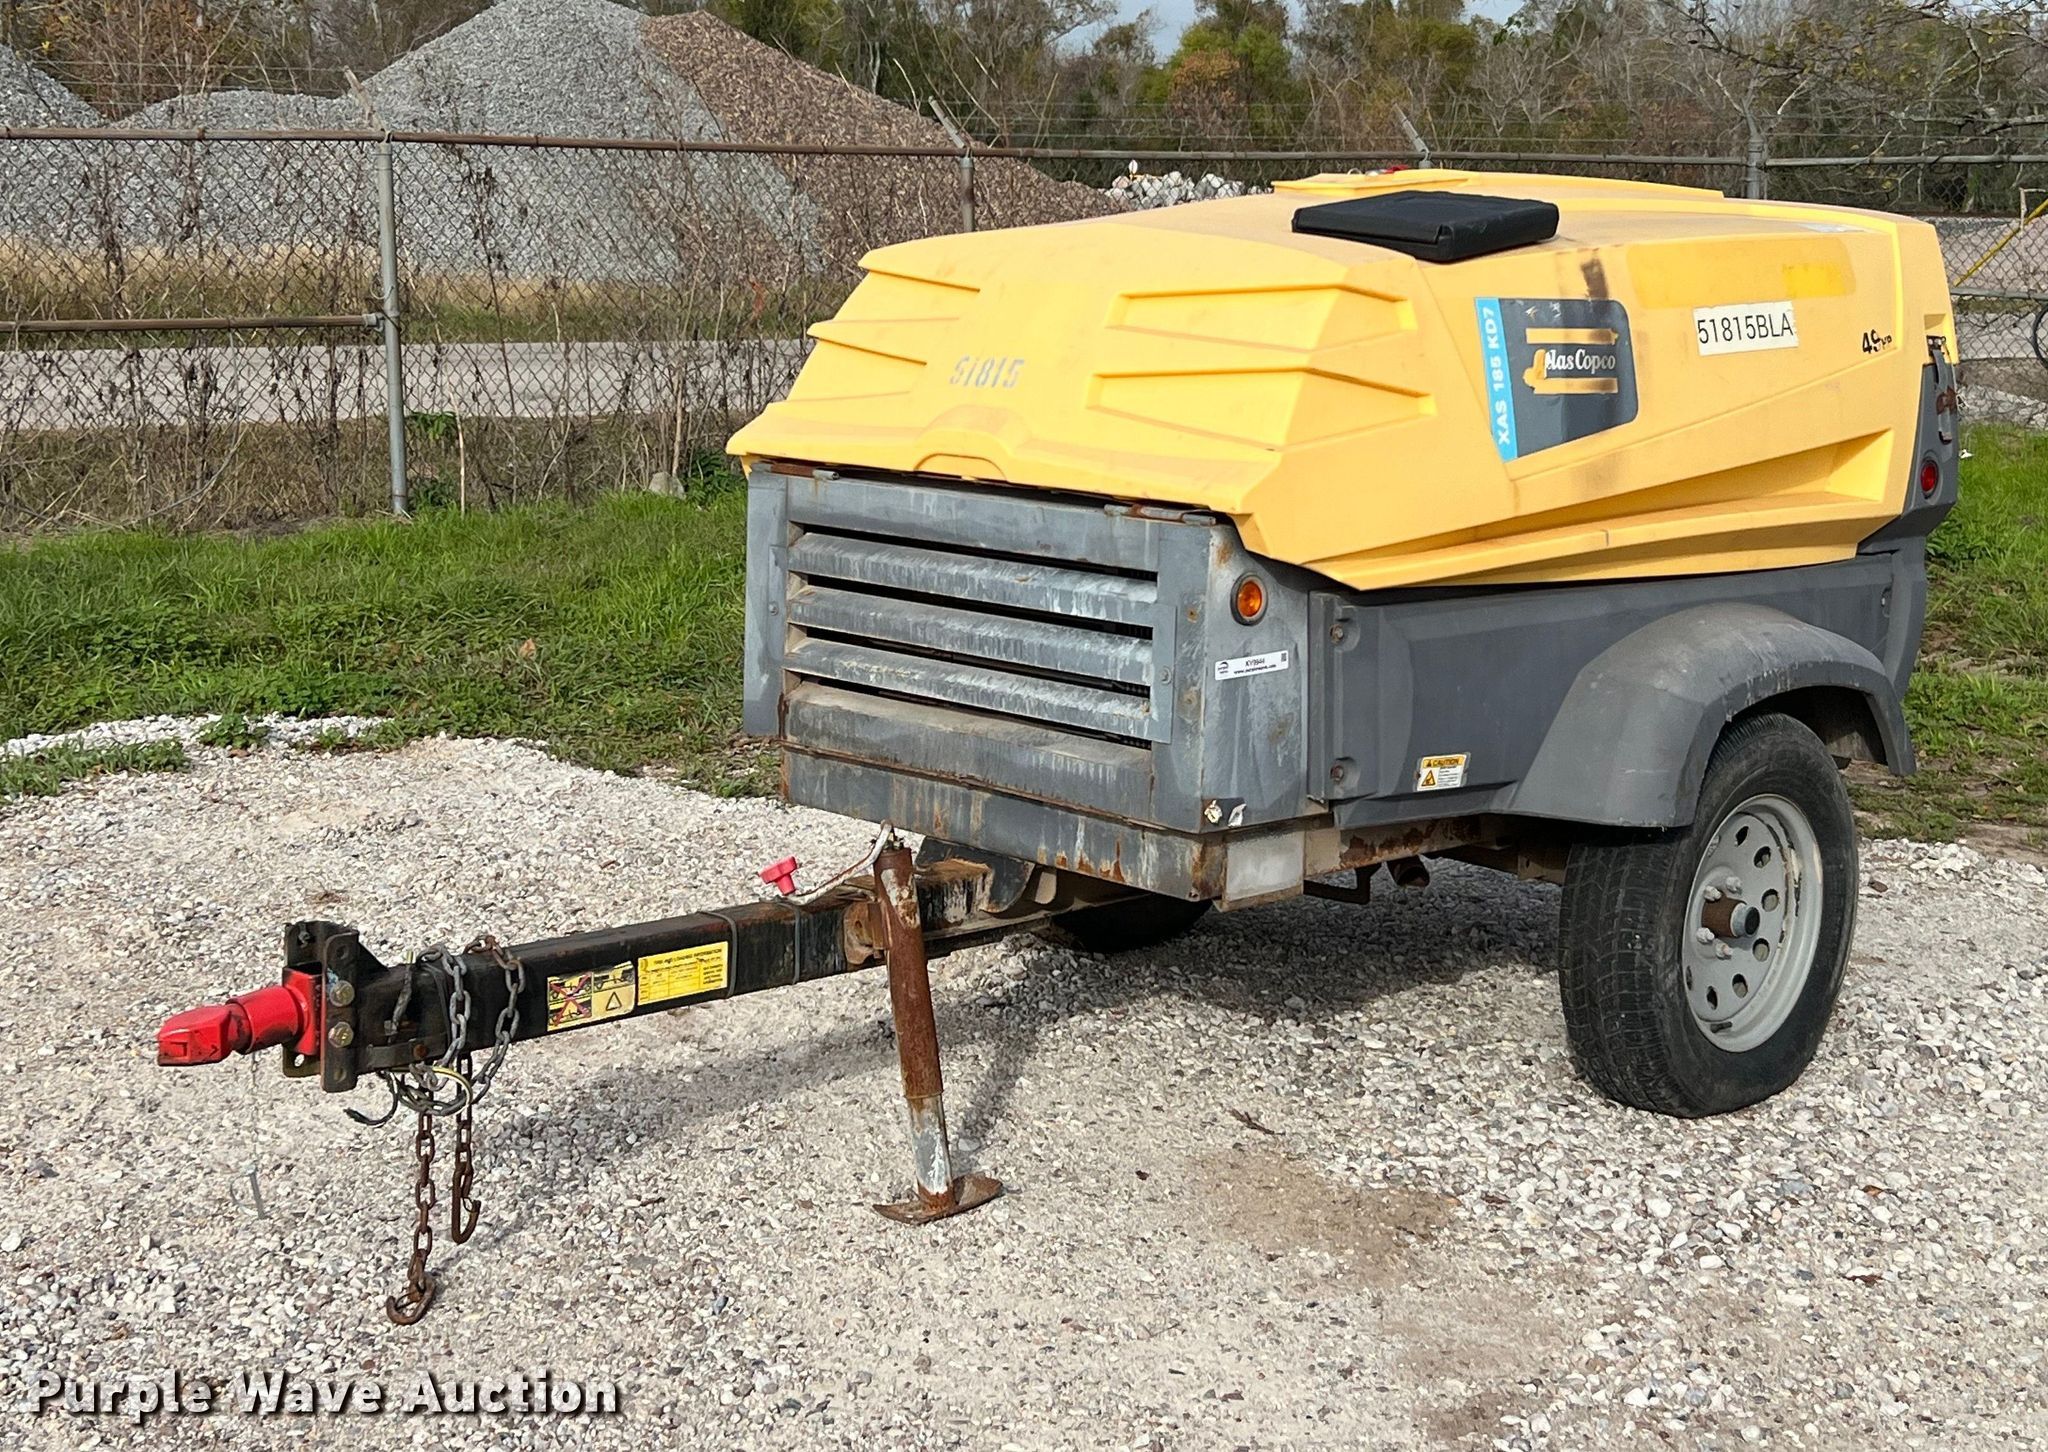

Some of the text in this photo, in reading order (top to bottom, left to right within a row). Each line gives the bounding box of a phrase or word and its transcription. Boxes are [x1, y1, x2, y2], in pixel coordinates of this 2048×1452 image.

[1697, 312, 1794, 344] 51815BLA
[949, 355, 1025, 388] 51815
[1483, 307, 1510, 445] XAS 185 KD7
[1575, 348, 1616, 374] Copco
